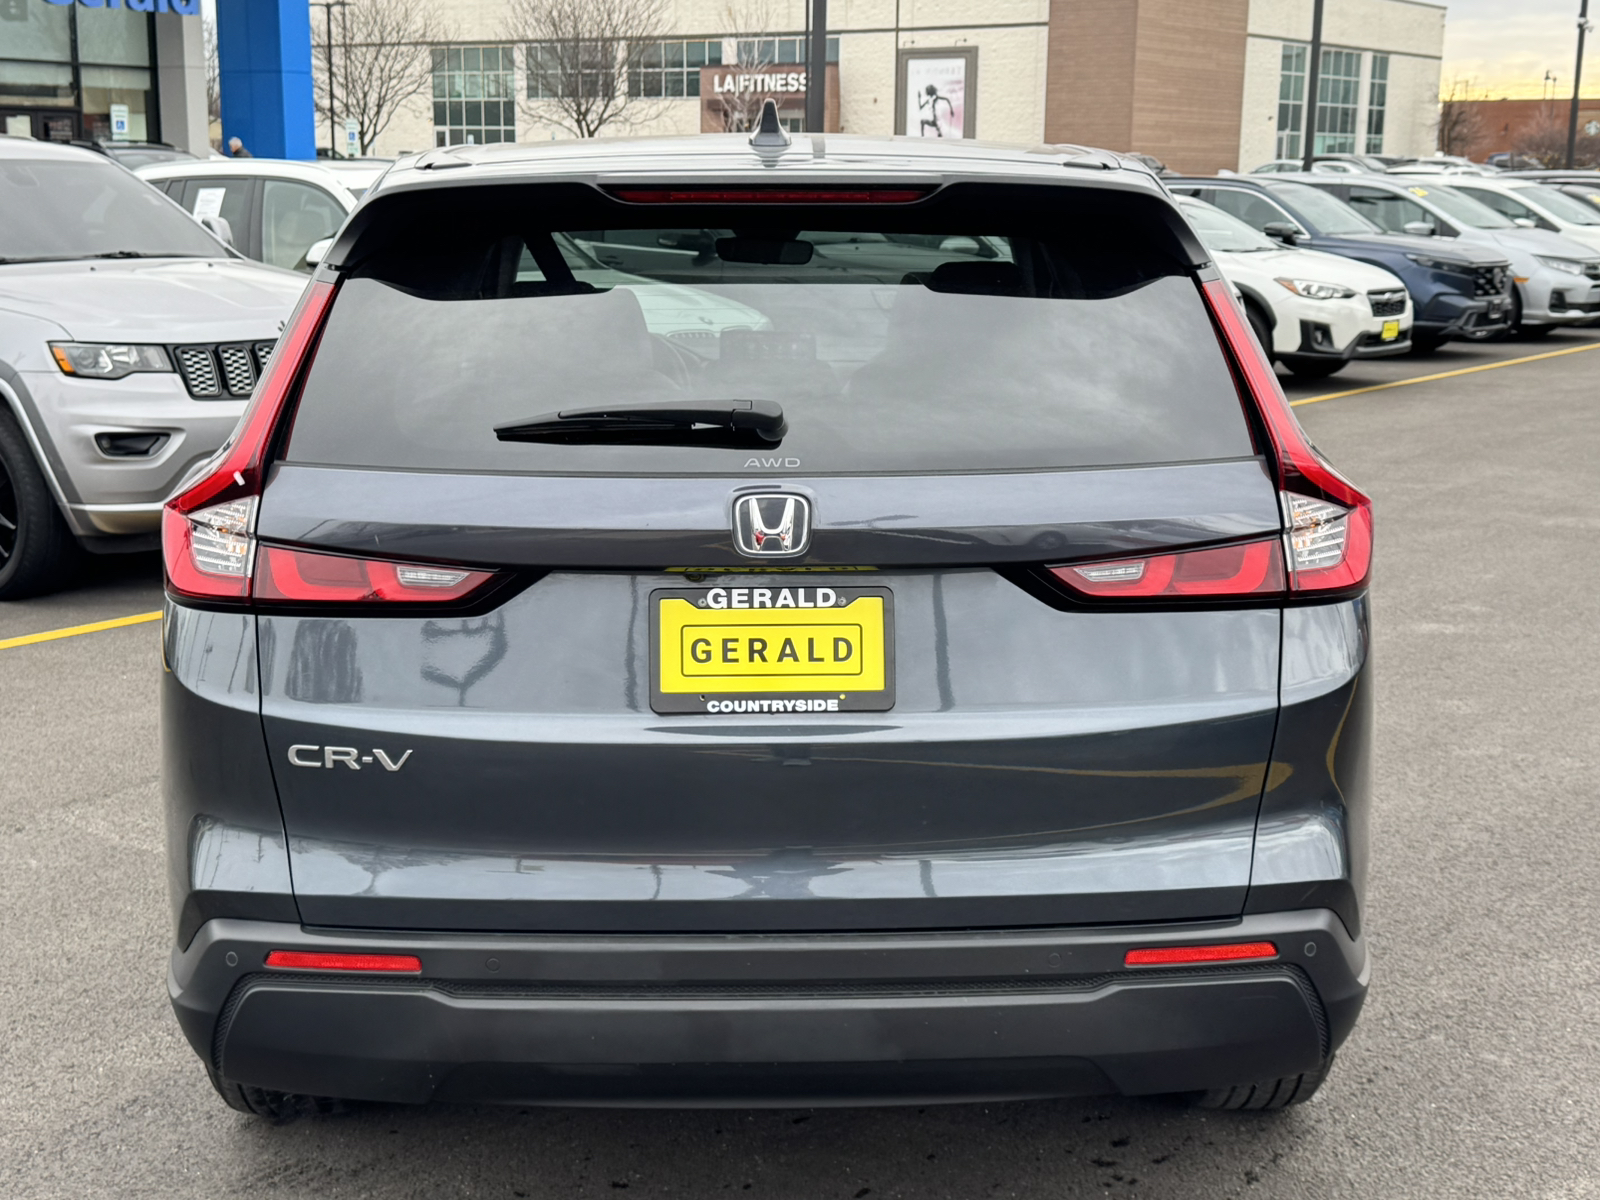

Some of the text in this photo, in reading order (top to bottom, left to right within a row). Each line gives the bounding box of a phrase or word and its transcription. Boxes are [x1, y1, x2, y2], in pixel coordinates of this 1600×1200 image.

[713, 74, 735, 93] LA
[744, 457, 801, 468] AWD
[706, 587, 837, 609] GERALD
[690, 637, 853, 664] GERALD
[706, 698, 839, 713] COUNTRYSIDE
[287, 744, 413, 772] CR-V
